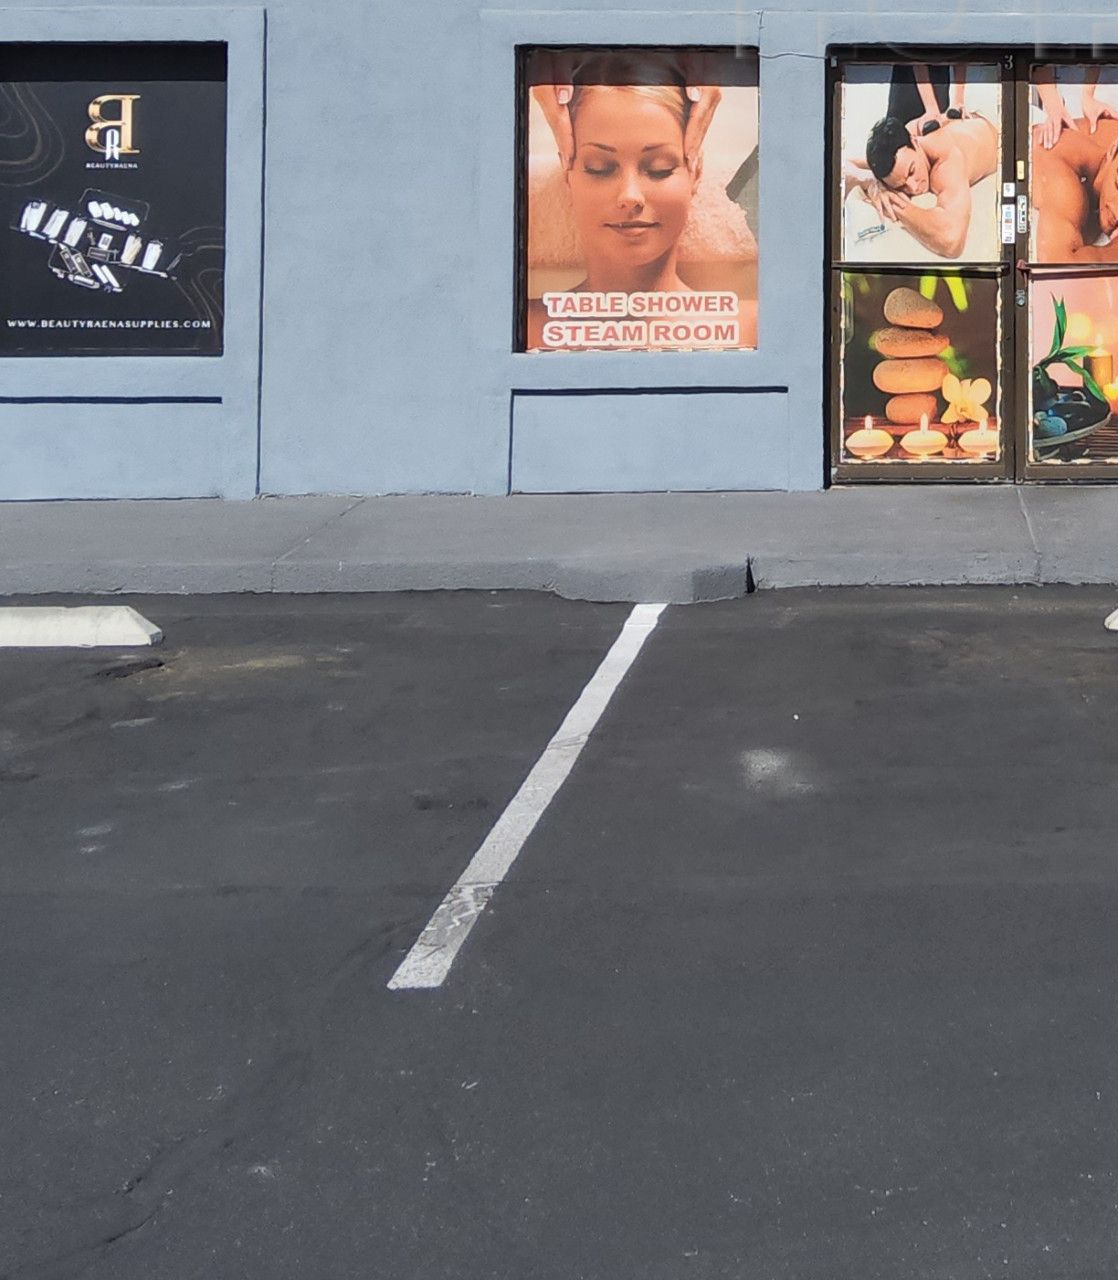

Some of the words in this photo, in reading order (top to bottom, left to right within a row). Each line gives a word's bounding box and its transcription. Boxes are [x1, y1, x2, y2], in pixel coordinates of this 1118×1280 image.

[1004, 54, 1014, 70] 3
[548, 296, 623, 313] TABLE
[631, 296, 734, 313] SHOWER
[7, 319, 211, 329] WWW.BEAUTYRAENASUPPLIES.COM
[547, 324, 644, 342] STEAM
[653, 324, 735, 342] ROOM
